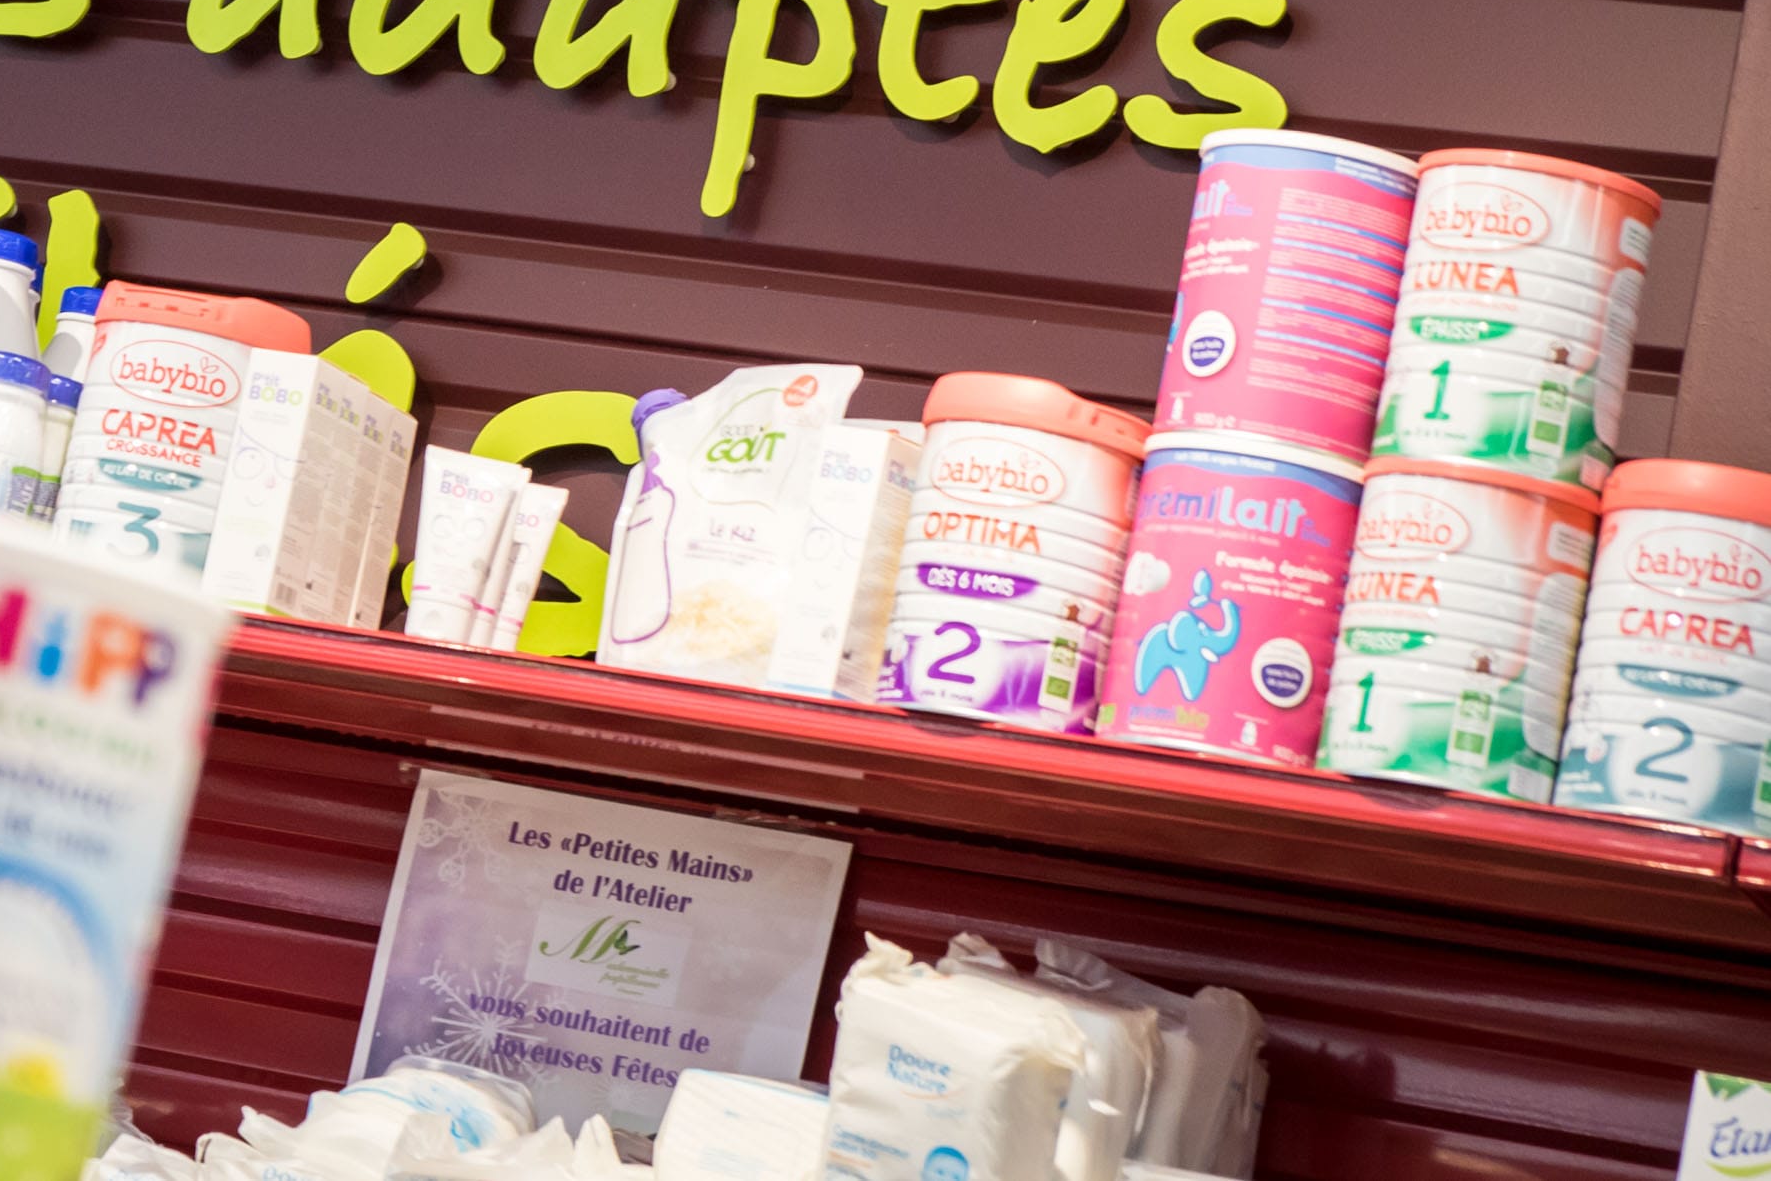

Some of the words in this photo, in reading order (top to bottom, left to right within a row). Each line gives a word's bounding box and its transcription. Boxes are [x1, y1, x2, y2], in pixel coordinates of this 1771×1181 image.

[1425, 200, 1532, 238] babybio
[1414, 262, 1519, 297] LUNEA
[118, 354, 227, 398] babybio
[249, 385, 304, 407] BOBO
[1423, 359, 1451, 421] 1
[101, 408, 217, 455] CAPREA
[106, 438, 202, 468] CROISSANCE
[820, 462, 873, 484] BOBO
[440, 481, 494, 503] BOBO
[937, 457, 1049, 495] babybio
[108, 501, 162, 560] 3
[516, 514, 540, 528] BO
[923, 511, 1043, 556] OPTIMA
[959, 569, 971, 589] 6
[973, 572, 1016, 597] MOIS
[1635, 545, 1762, 591] babybio
[1619, 607, 1756, 657] CAPREA
[927, 621, 981, 685] 2
[1349, 670, 1374, 733] 1
[1634, 717, 1694, 784] 2
[508, 821, 552, 850] Les
[553, 869, 584, 894] de
[469, 993, 527, 1020] vous
[534, 1005, 672, 1048] souhaitent
[679, 1028, 711, 1054] de
[491, 1032, 604, 1075] Joyeuses
[611, 1054, 679, 1089] Fêtes
[889, 1043, 951, 1077] Douce
